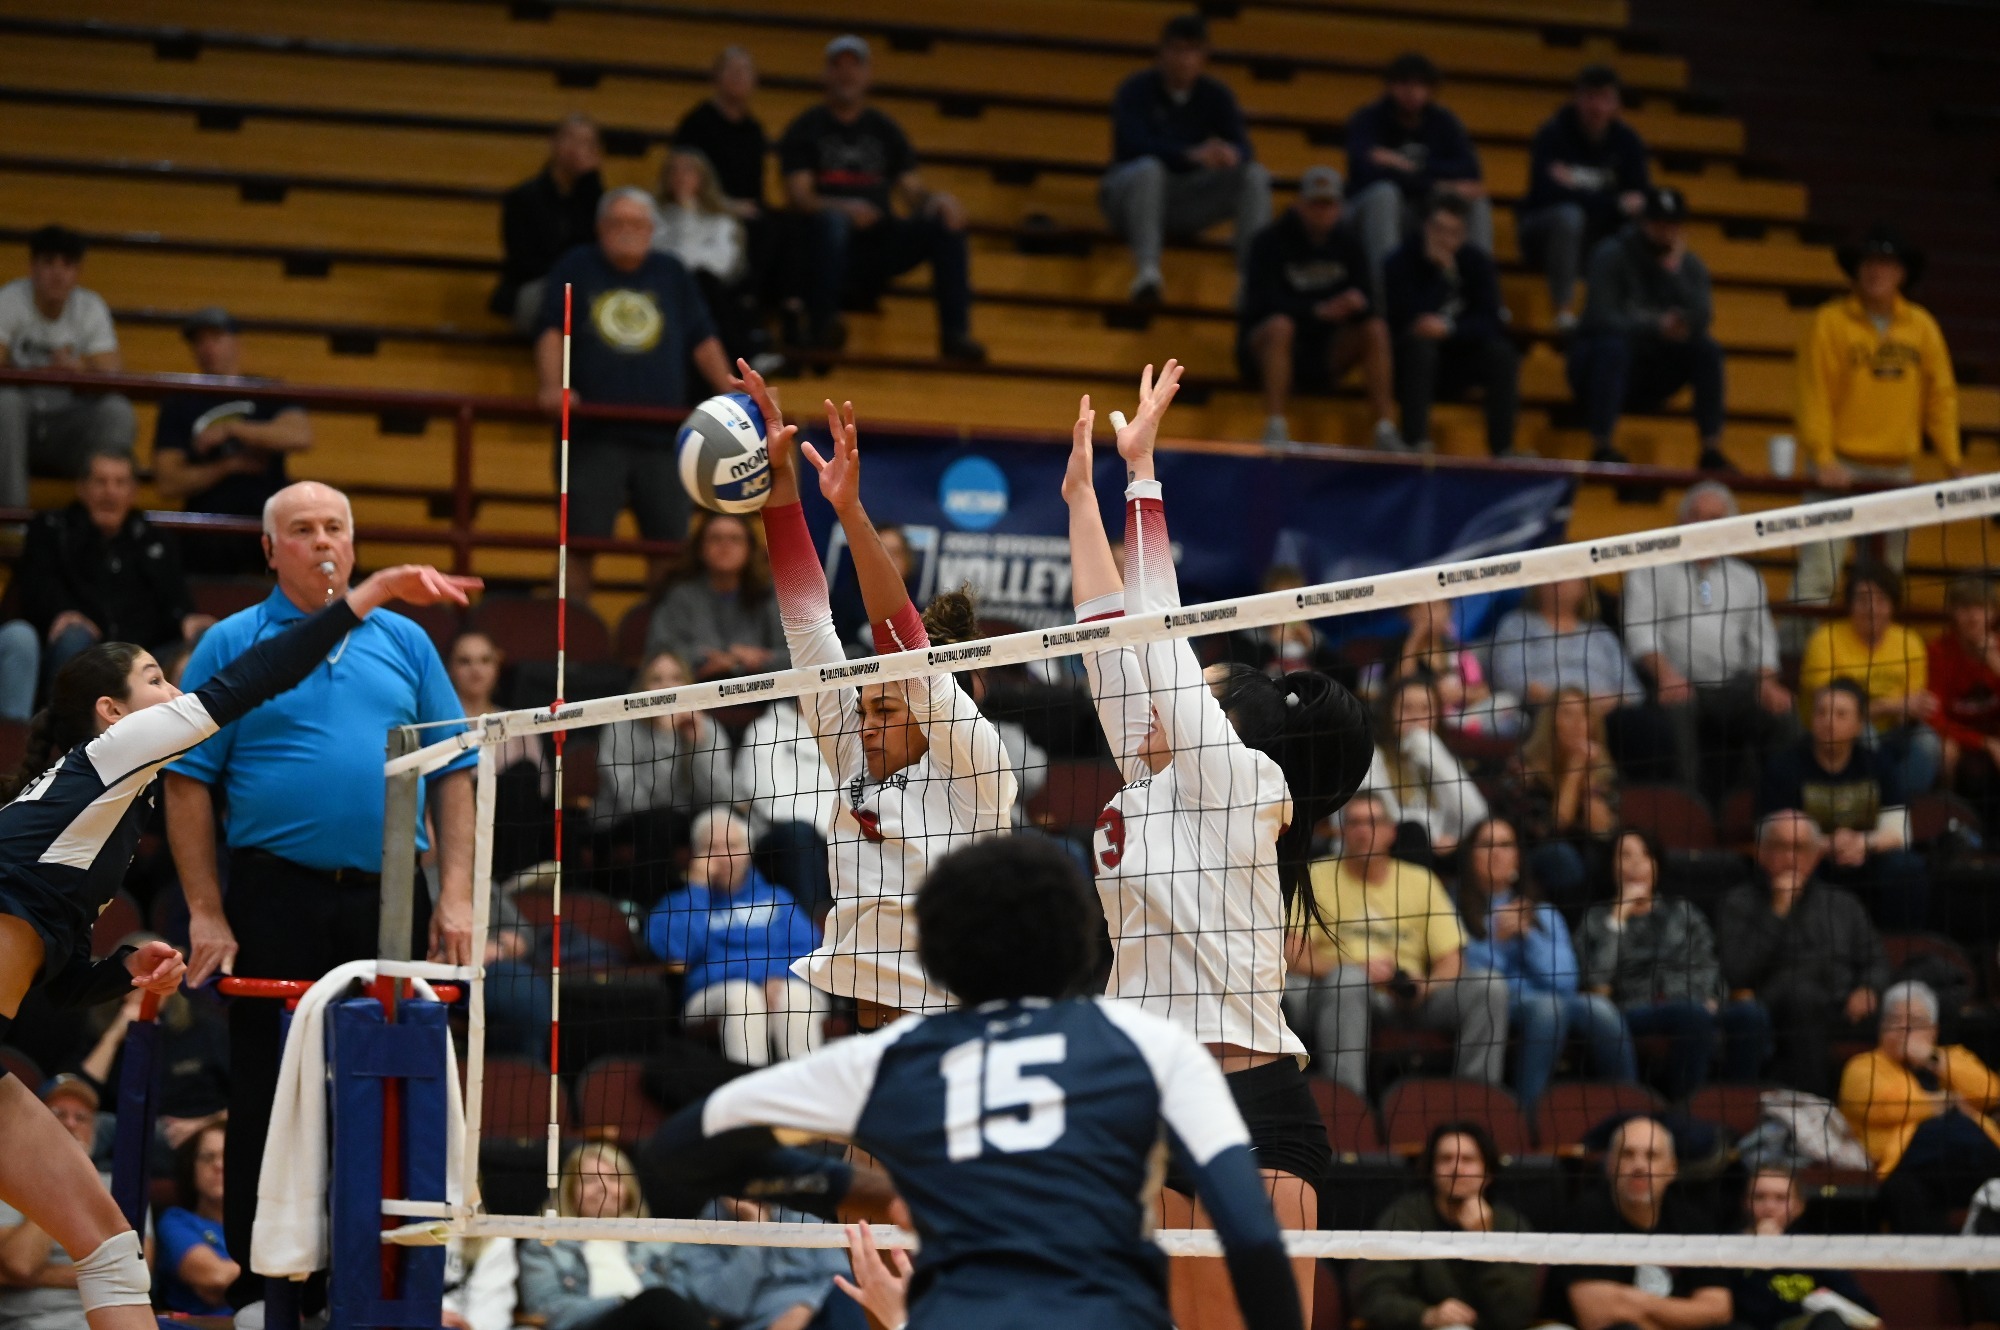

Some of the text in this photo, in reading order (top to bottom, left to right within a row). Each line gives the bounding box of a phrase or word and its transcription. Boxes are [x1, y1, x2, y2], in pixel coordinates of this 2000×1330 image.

[1446, 560, 1522, 584] VOLLEYBALL CHAMPIONSHIP
[1304, 584, 1375, 606] VOLLEYBALL CHAMPIONSHIP
[1172, 606, 1238, 627] VOLLEYBALL CHAMPIONSHIP
[1049, 626, 1111, 646] VOLLEYBALL CHAMPIONSHIP
[933, 644, 992, 663] VOLLEYBALL CHAMPIONSHIP
[825, 661, 880, 680] VOLLEYBALL CHAMPIONSHIP
[724, 678, 775, 695] VOLLEYBALL CHAMPIONSHIP
[629, 692, 677, 709] VOLLEYBALL CHAMPIONSHIP
[1093, 806, 1126, 875] 3
[939, 1033, 1066, 1162] 15
